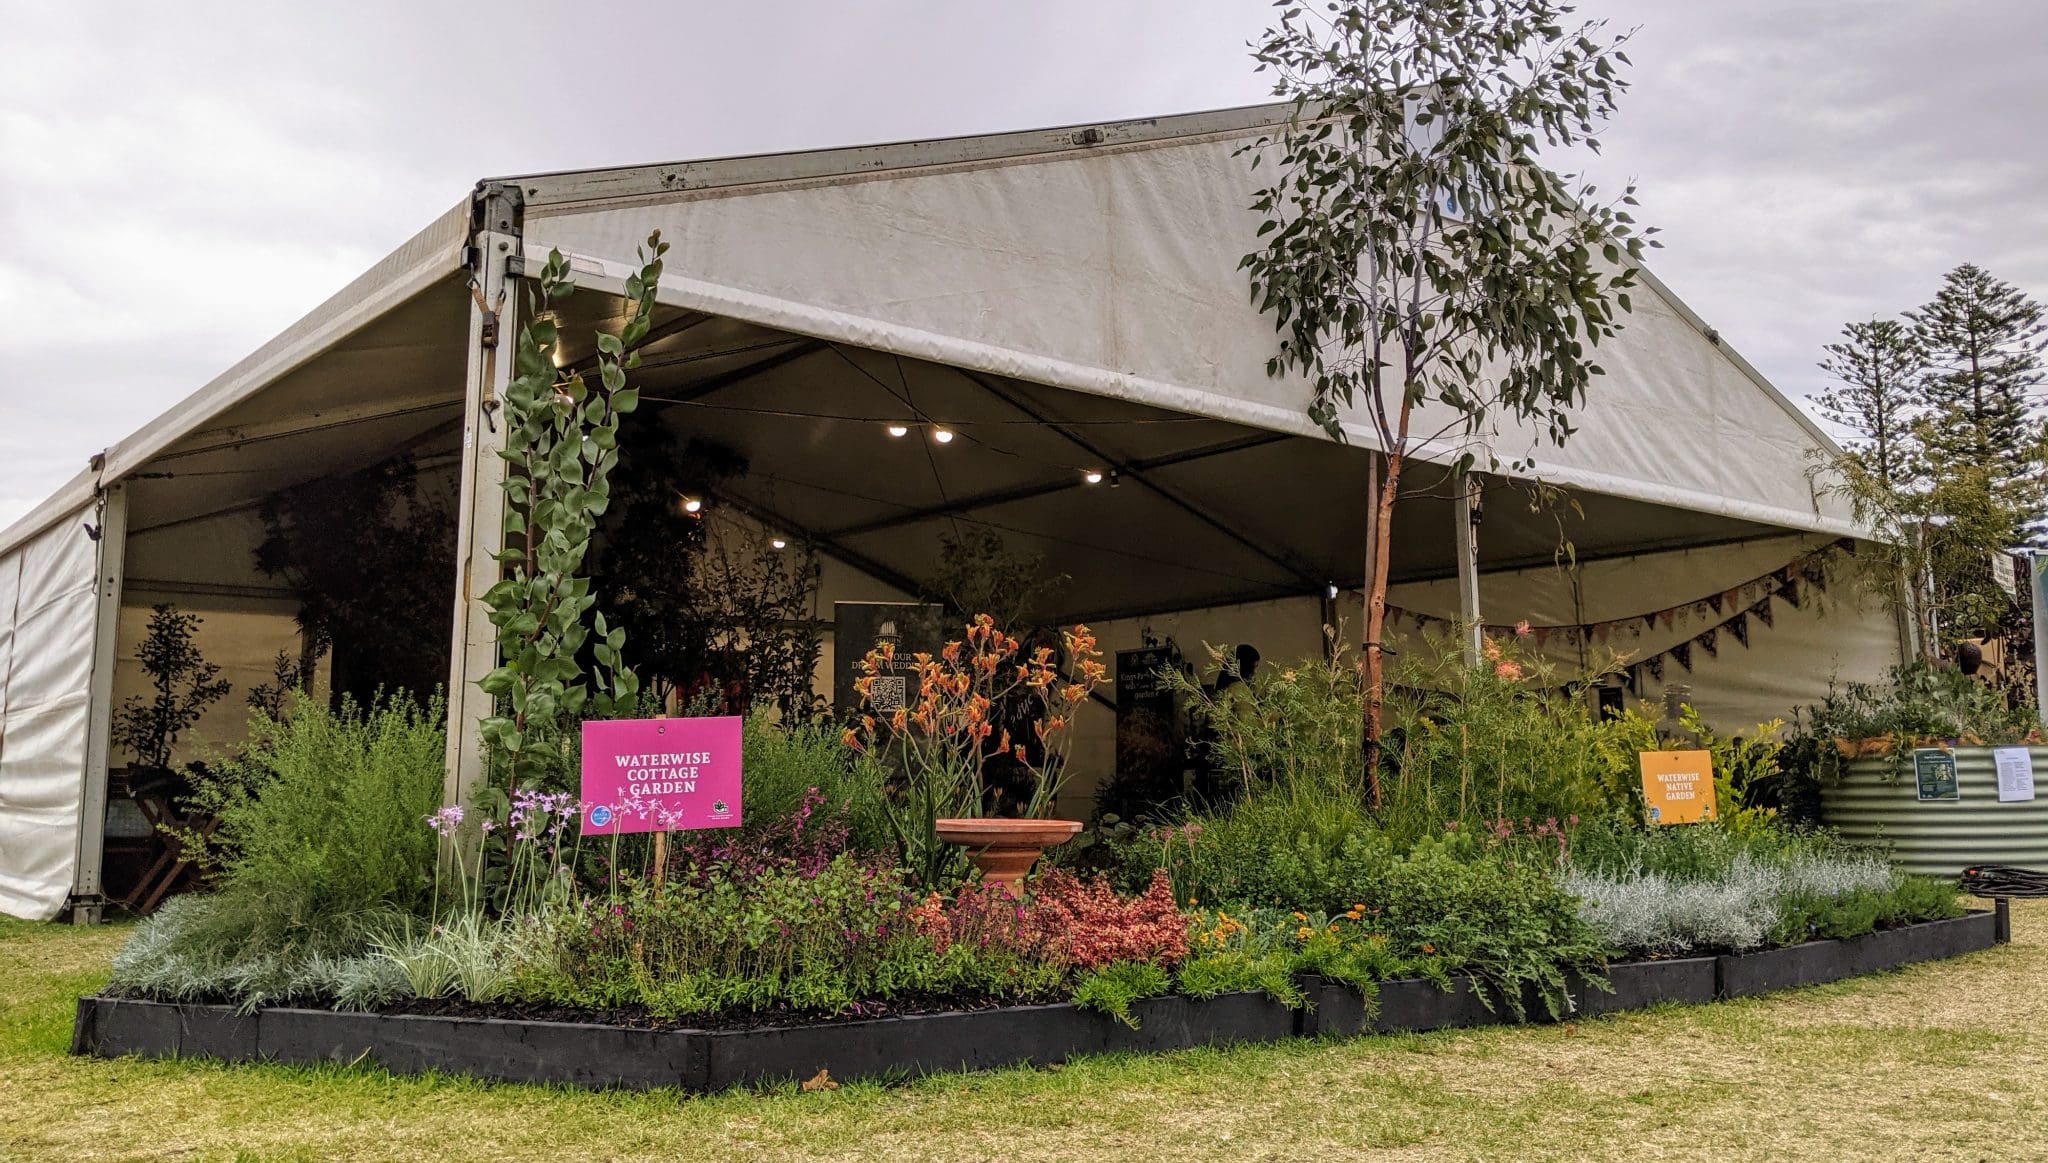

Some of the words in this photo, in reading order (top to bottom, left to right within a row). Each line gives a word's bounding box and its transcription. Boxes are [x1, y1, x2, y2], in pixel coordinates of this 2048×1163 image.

[615, 752, 711, 767] WATERWISE
[627, 767, 699, 781] COTTAGE
[1657, 773, 1700, 782] WATERWISE
[629, 781, 696, 796] GARDEN
[1666, 783, 1693, 791] NATIVE
[1666, 792, 1695, 800] GARDEN
